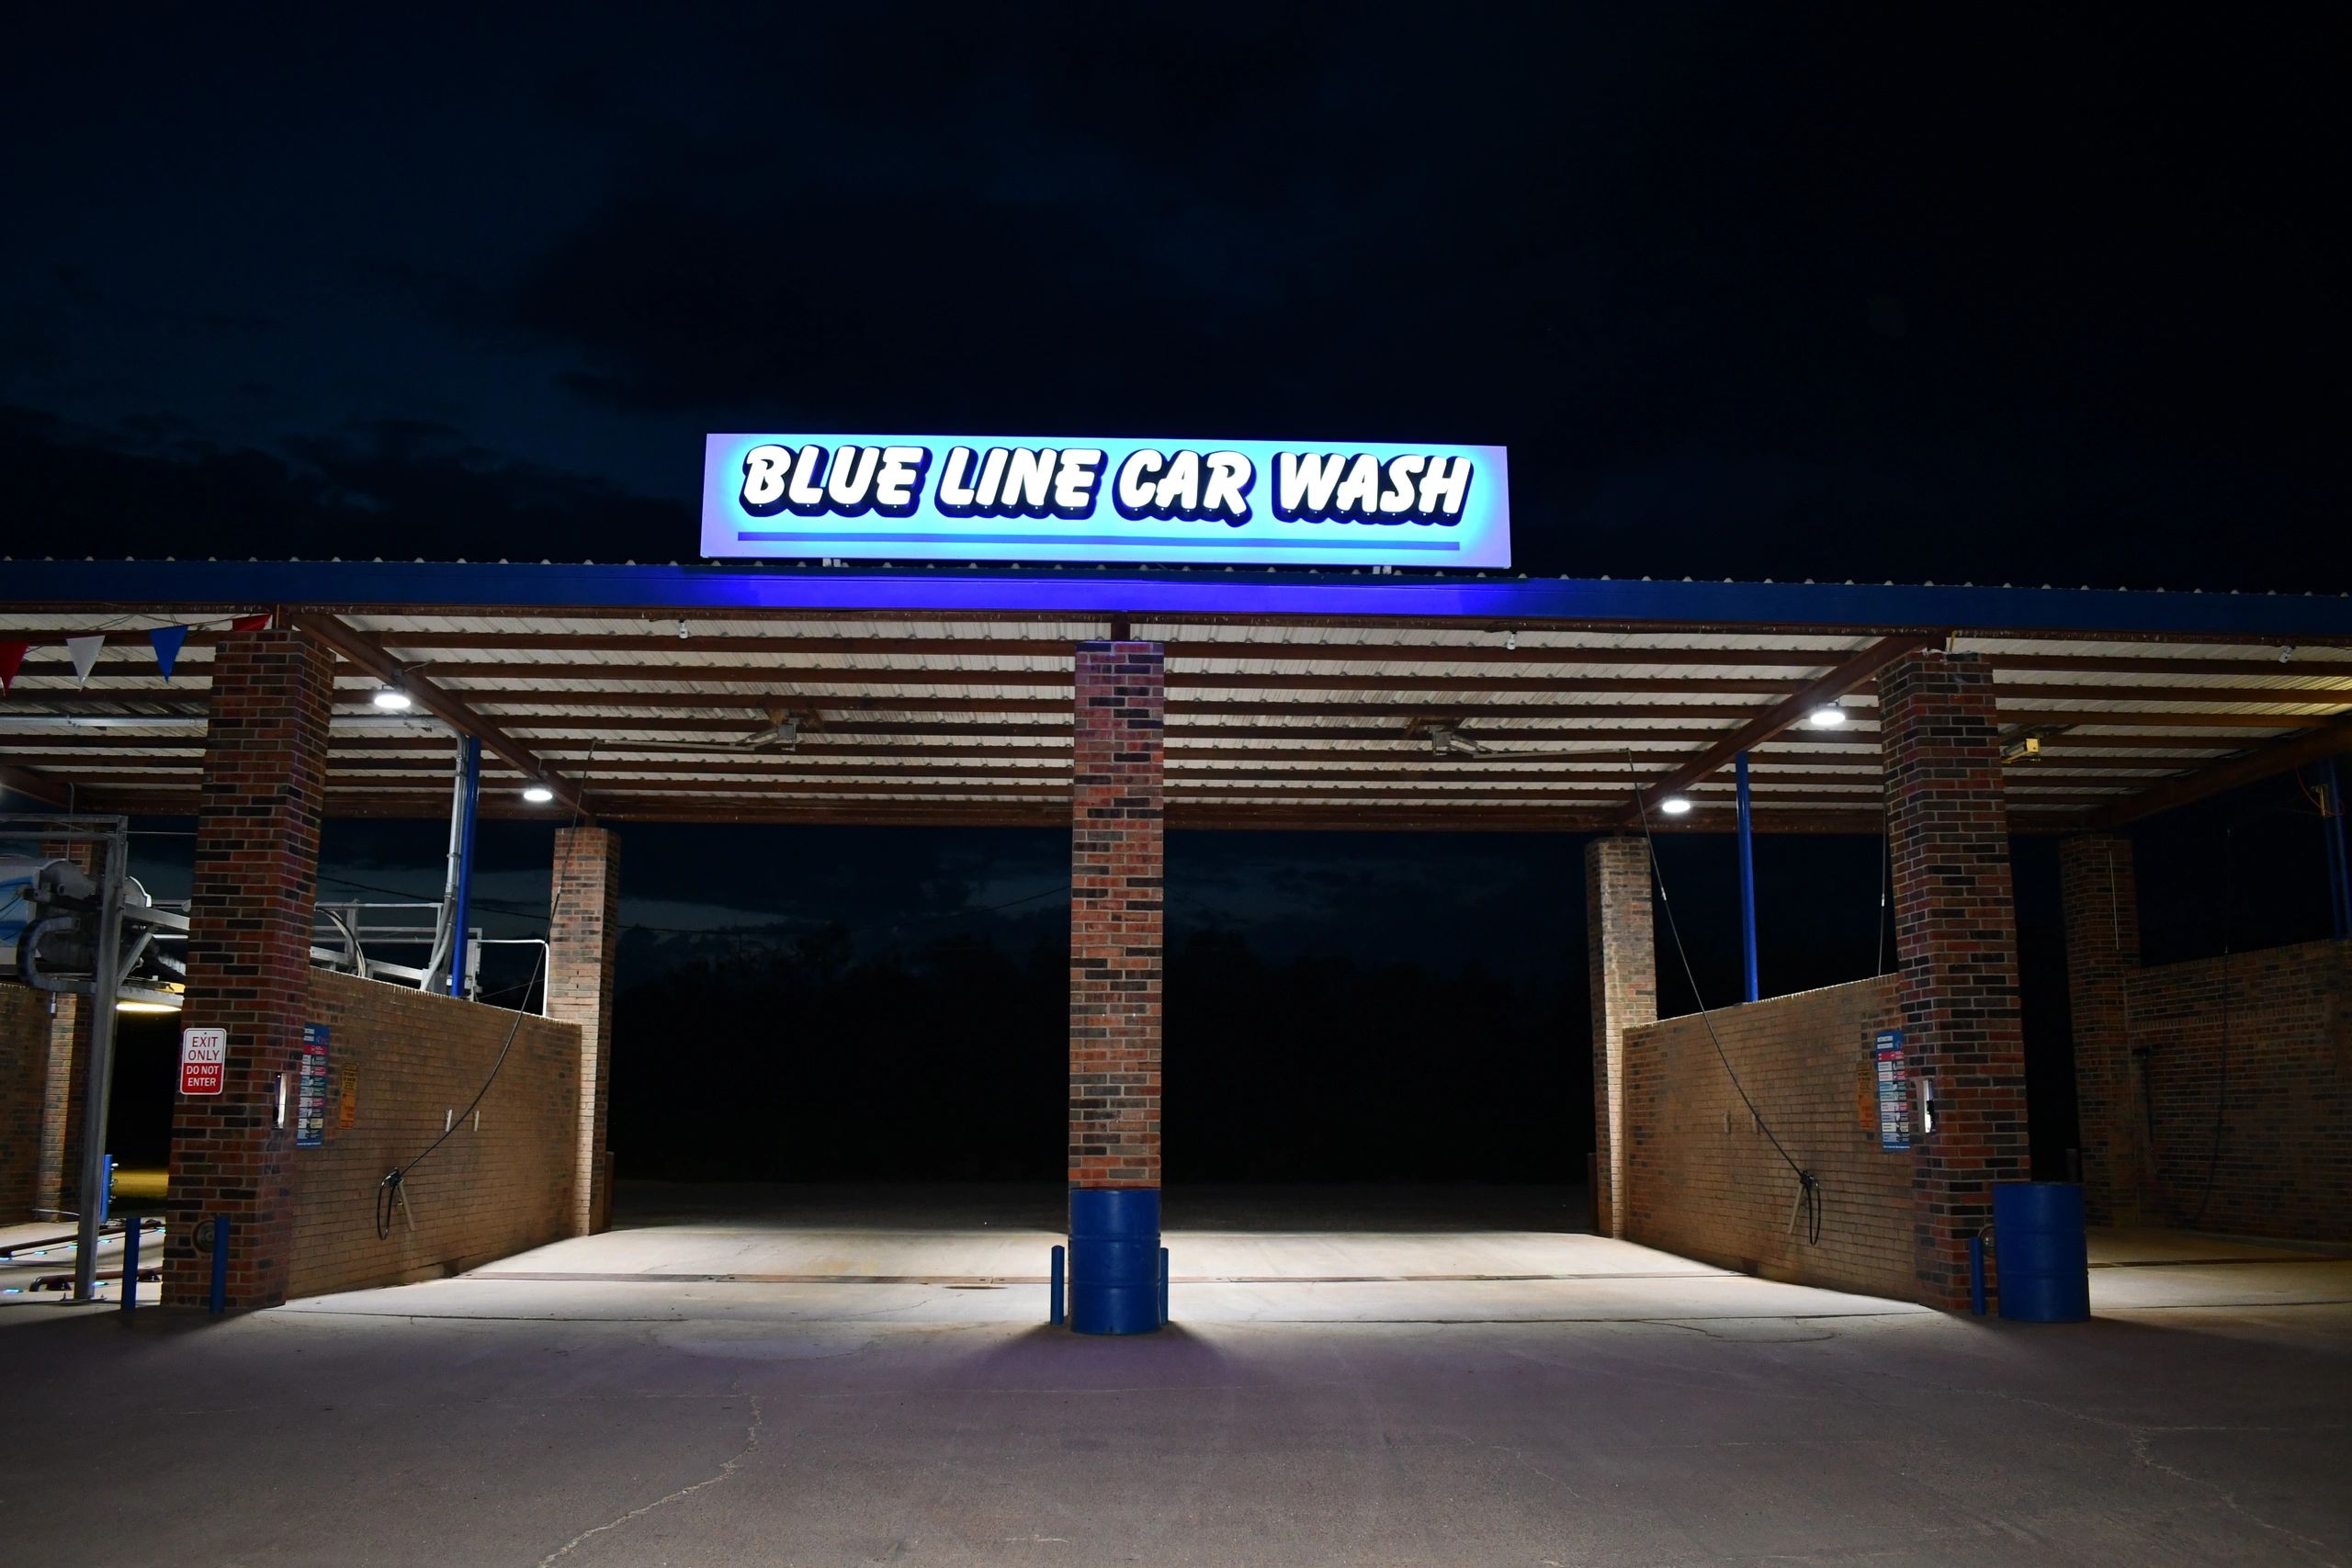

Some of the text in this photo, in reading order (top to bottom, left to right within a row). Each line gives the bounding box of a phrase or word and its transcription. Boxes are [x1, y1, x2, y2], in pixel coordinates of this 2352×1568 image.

[739, 445, 1474, 527] BLUE LINE CAR WASH
[192, 1036, 218, 1047] EXIT
[187, 1050, 220, 1061] ONLY
[187, 1066, 220, 1075] DO NOT
[187, 1077, 216, 1087] ENTER
